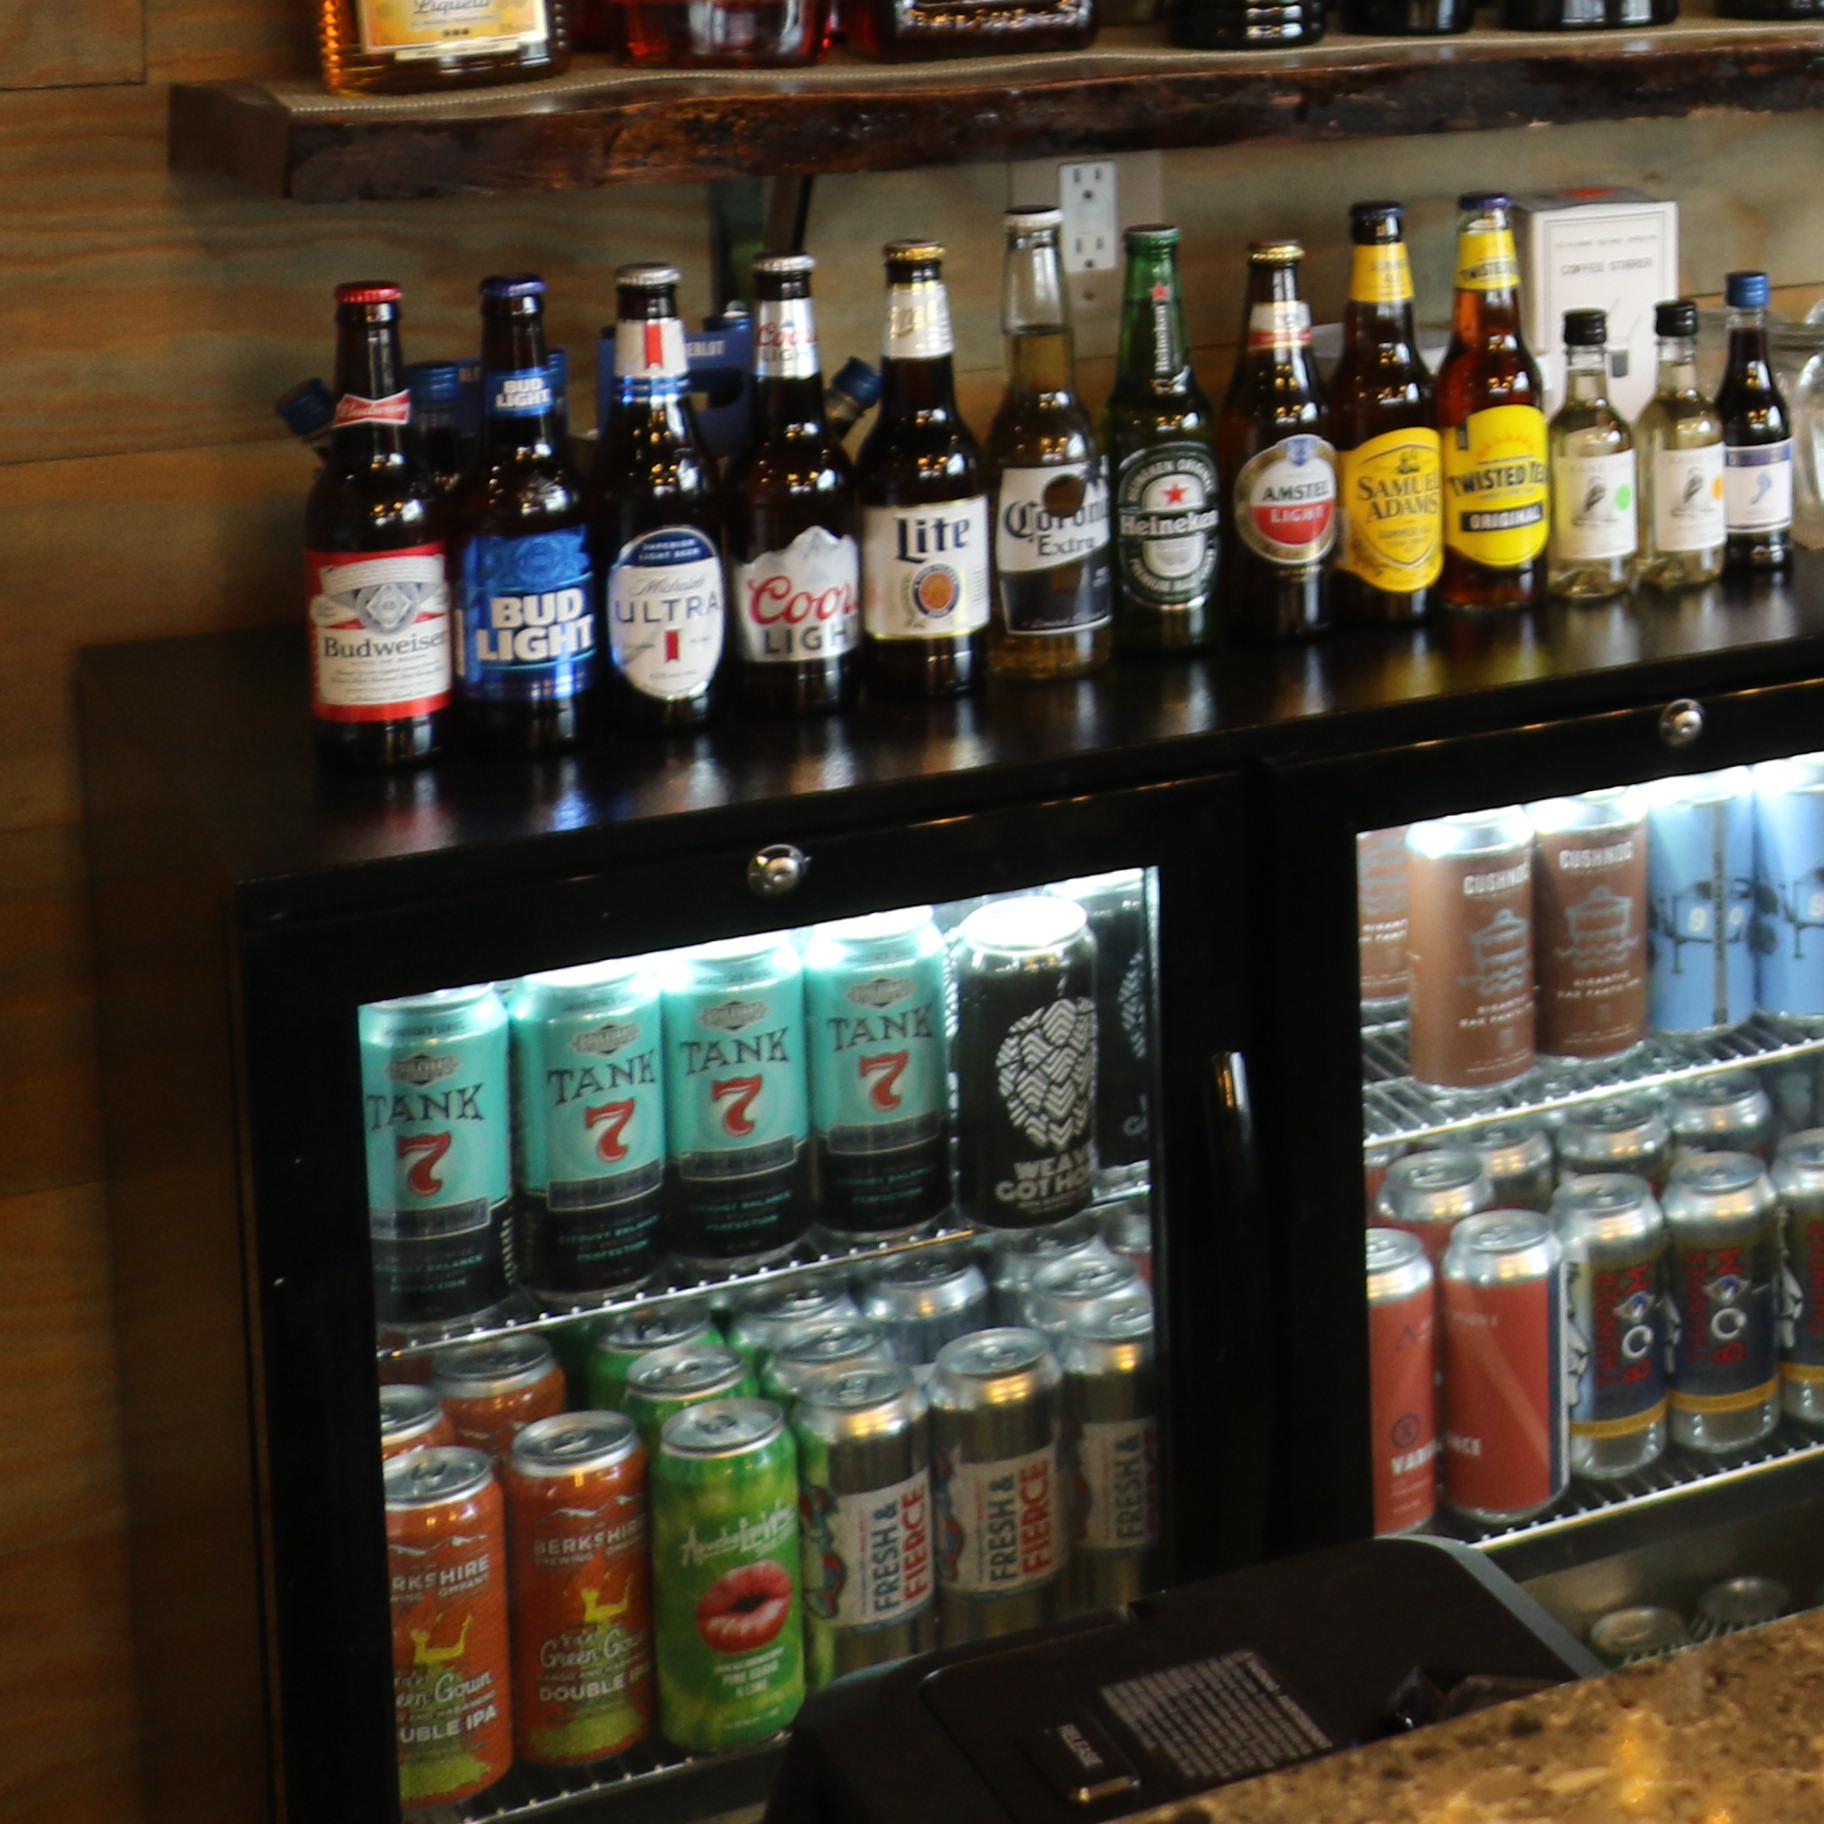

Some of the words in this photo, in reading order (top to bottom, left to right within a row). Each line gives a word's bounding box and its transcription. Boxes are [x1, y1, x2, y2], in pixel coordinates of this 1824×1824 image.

[1156, 306, 1170, 373] Heineken
[495, 389, 551, 409] LIGHT
[502, 376, 544, 394] BUD
[1261, 480, 1331, 502] AMSTEL
[1450, 462, 1524, 496] TWISTED
[1120, 509, 1220, 536] Heineken
[1269, 505, 1328, 526] LIGHT
[1366, 494, 1441, 524] ADAMS
[1469, 503, 1543, 531] ORIGINAL
[894, 512, 971, 564] Lite
[1037, 535, 1097, 557] Extra
[490, 587, 585, 630] BUD
[615, 596, 722, 626] ULTRA
[476, 612, 596, 663] LIGHT
[680, 1027, 790, 1076] TANK
[827, 1004, 935, 1054] TANK
[547, 1048, 657, 1107] TANK
[859, 1049, 910, 1113] 7
[364, 1082, 486, 1131] TANK
[711, 1073, 764, 1138] 7
[585, 1097, 636, 1164] 7
[396, 1131, 453, 1198] 7
[988, 1472, 1016, 1495] &
[1115, 1458, 1145, 1541] FRESH
[873, 1499, 899, 1522] &
[1019, 1459, 1053, 1575] FIERCE
[901, 1483, 929, 1602] FIERCE
[987, 1496, 1019, 1582] FRESH
[872, 1530, 902, 1614] FRESH
[539, 1674, 624, 1704] DOUBLE
[465, 1705, 497, 1733] IPA
